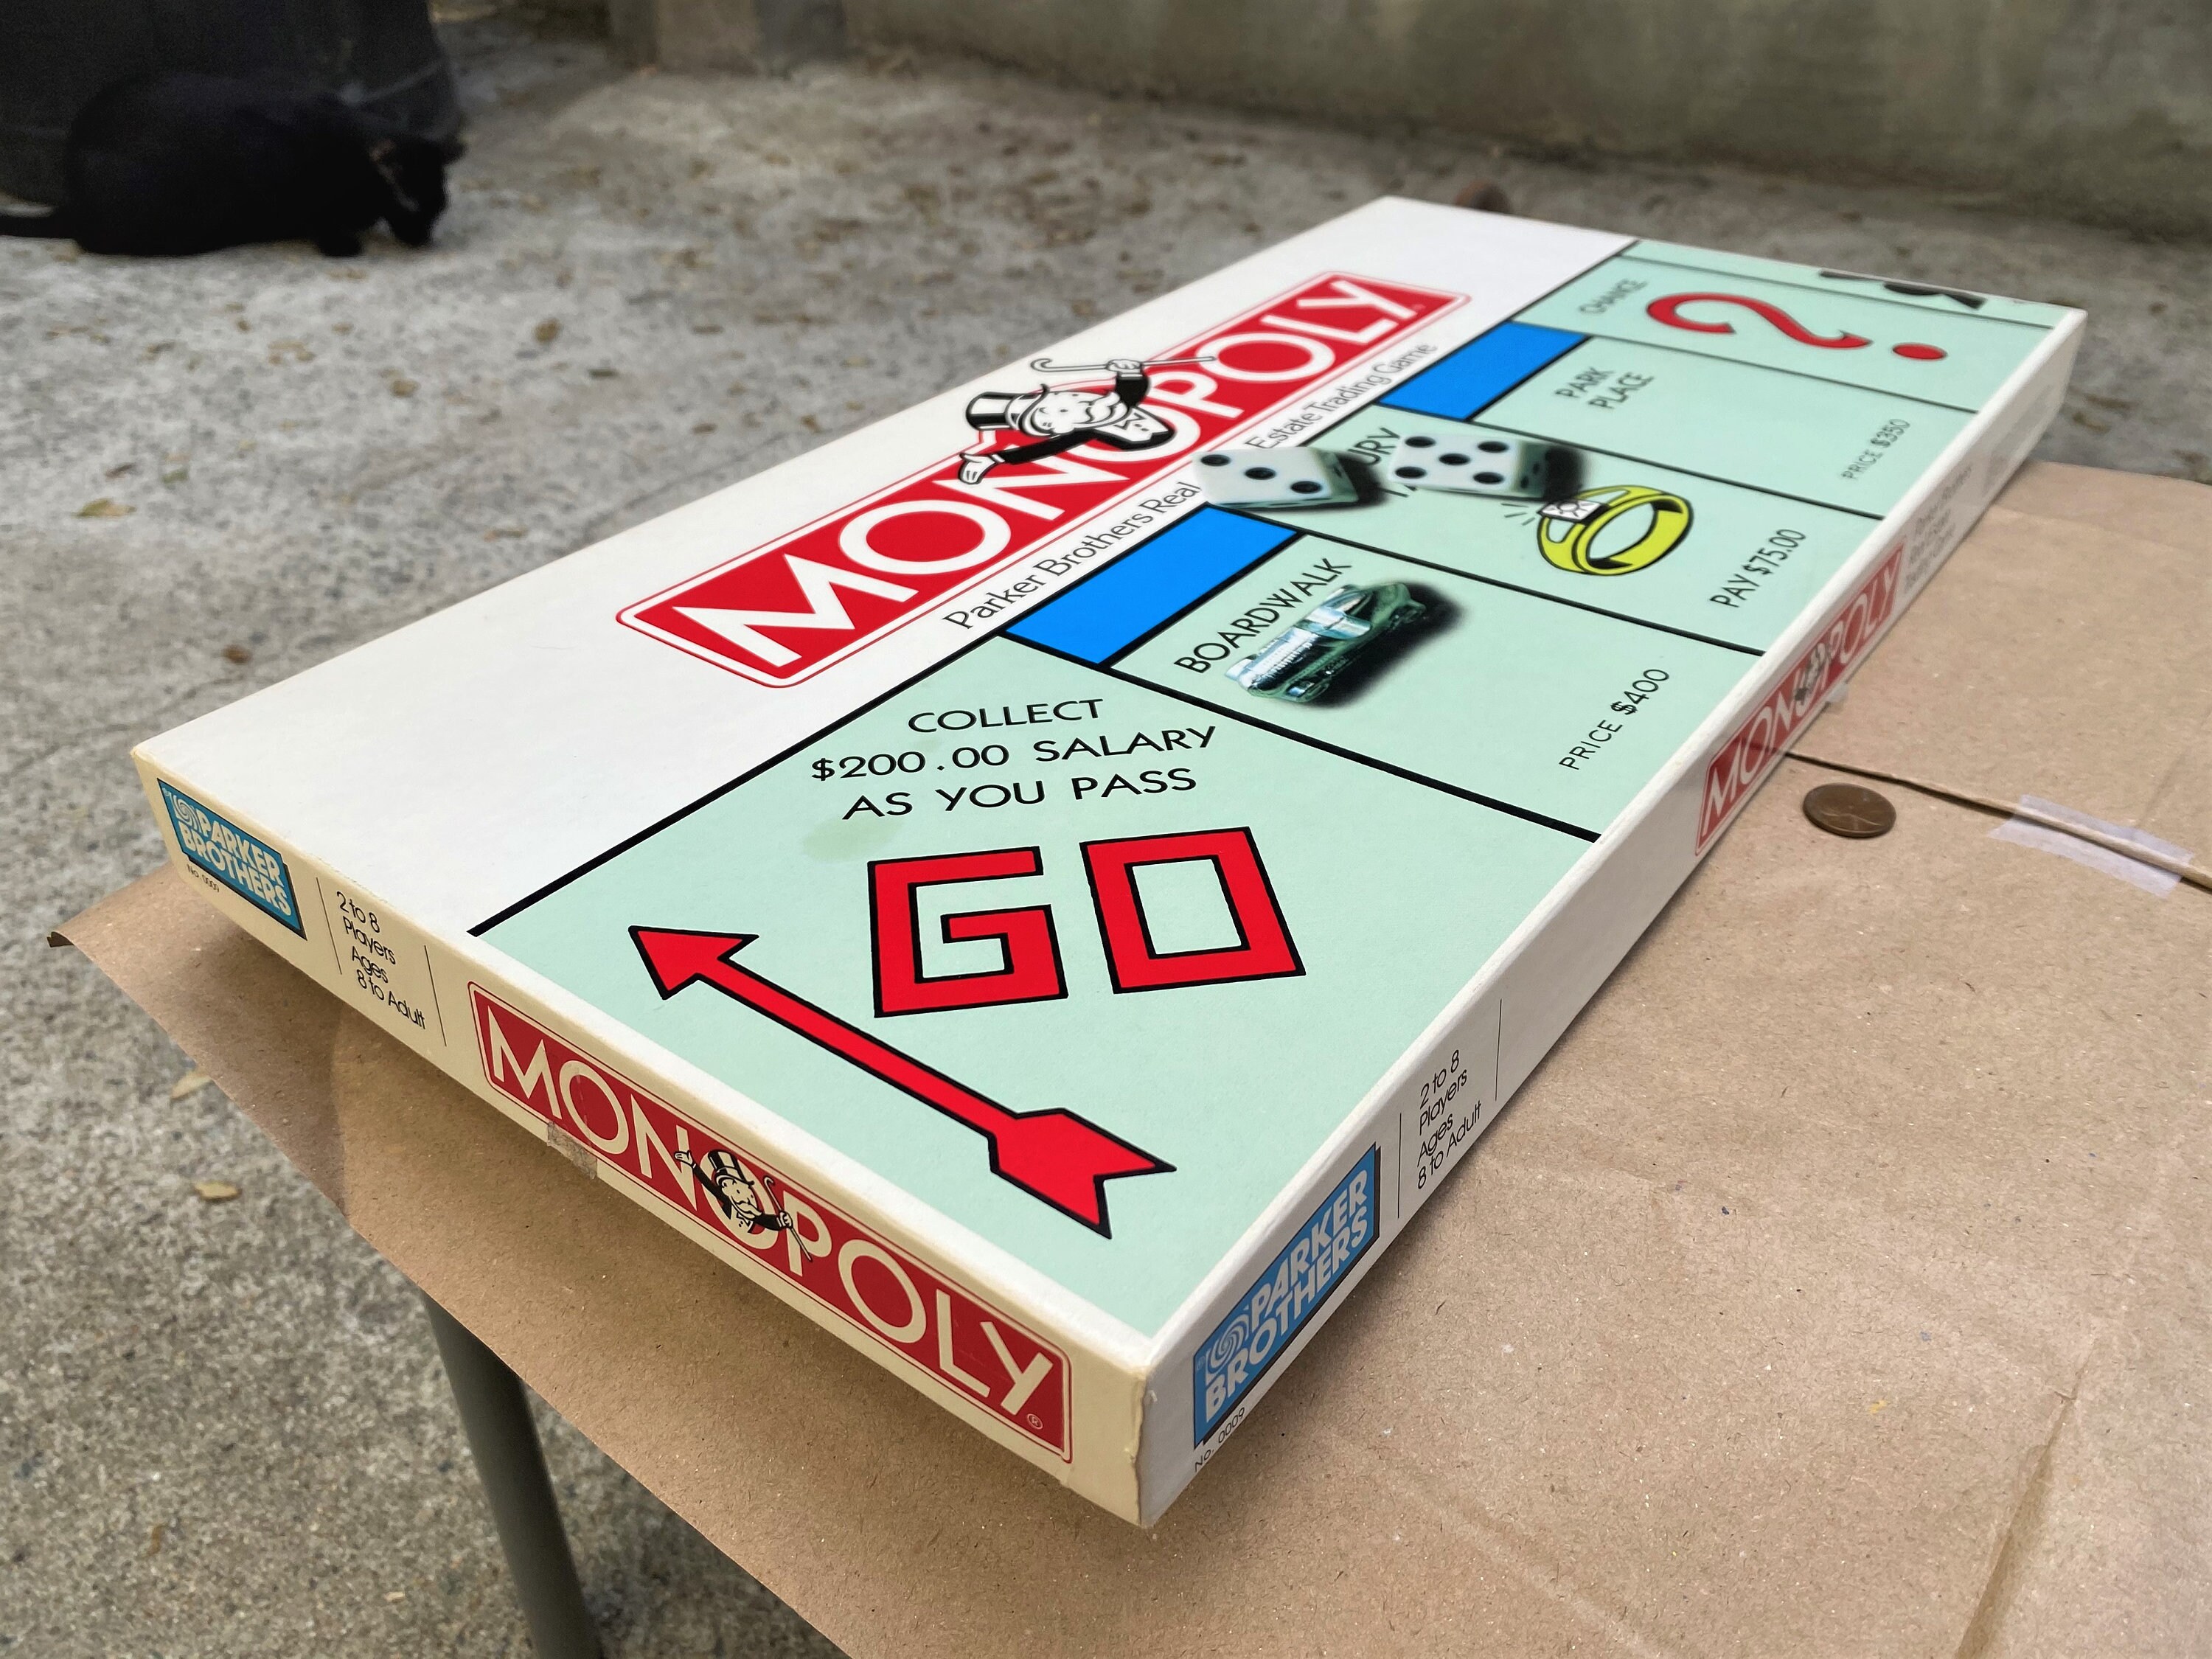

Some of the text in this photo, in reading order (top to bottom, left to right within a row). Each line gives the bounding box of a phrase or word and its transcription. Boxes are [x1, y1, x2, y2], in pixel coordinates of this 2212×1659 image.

[1554, 366, 1615, 398] PARK
[1588, 372, 1655, 409] PLACE
[672, 279, 1417, 667] MONOPOLY
[1347, 428, 1399, 465] URY
[1841, 419, 1910, 479] PRICE $350
[943, 344, 1438, 630] Parker Brothers Real Estate Trading Game
[1710, 529, 1806, 608] PAY $75.00
[1174, 557, 1352, 673] BOARDWALK
[908, 698, 1104, 733] COLLECT
[1033, 726, 1216, 762] SALARY
[1559, 669, 1669, 770] PRICE $400
[842, 768, 1197, 820] AS YOU PASS
[178, 820, 292, 916] BROTHERS
[195, 808, 284, 887] PARKER
[336, 891, 380, 933] 2 to 8
[343, 916, 396, 964] Players
[867, 826, 1307, 1018] GO
[352, 946, 388, 983] Ages
[357, 969, 425, 1029] 8 to Adult
[1419, 1069, 1467, 1135] Players
[1420, 1049, 1459, 1110] 2 to 8
[1417, 1113, 1453, 1167] Ages
[1418, 1100, 1481, 1189] 8 to Adult
[487, 1005, 1054, 1416] MONOPOLY
[1251, 1169, 1367, 1331] PARKER
[1206, 1206, 1367, 1422] BROTHERS
[1218, 1407, 1245, 1444] 0009
